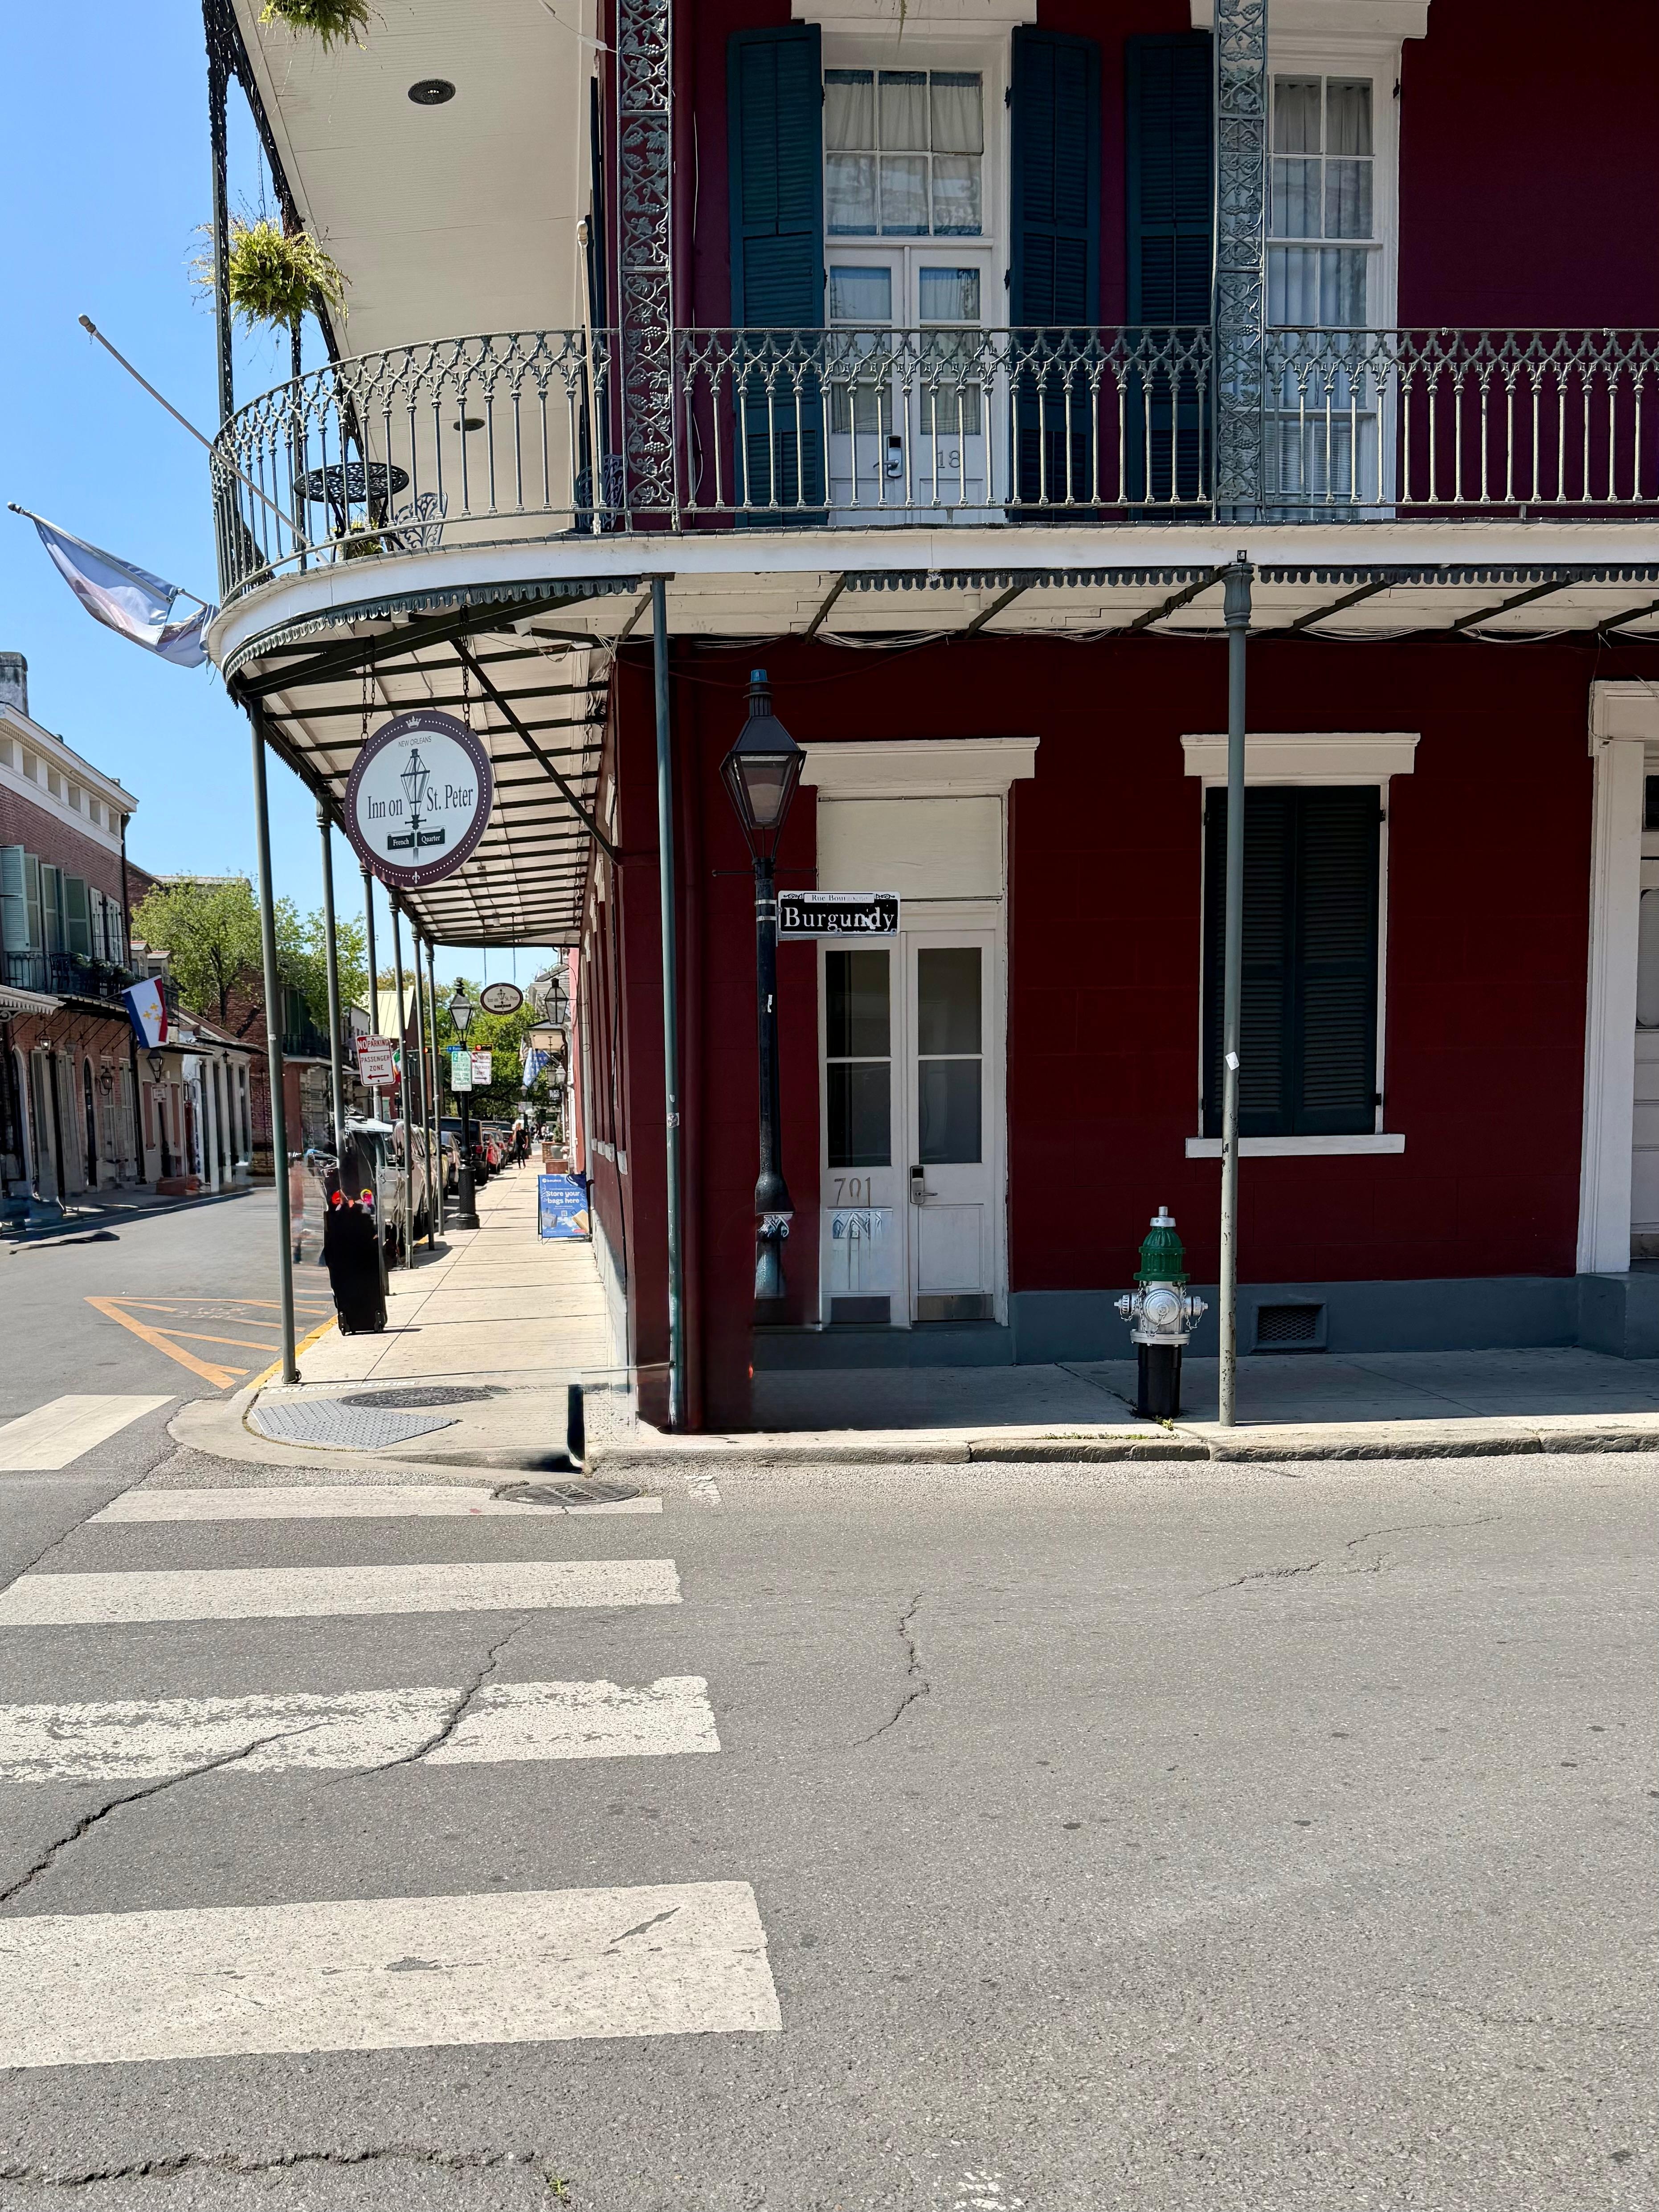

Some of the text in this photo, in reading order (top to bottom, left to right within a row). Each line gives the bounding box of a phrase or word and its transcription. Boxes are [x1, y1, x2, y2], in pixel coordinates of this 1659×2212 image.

[936, 450, 960, 468] 18
[410, 736, 432, 746] ORLEANS
[368, 785, 473, 819] Inn on St. Peter
[393, 835, 441, 846] French Quarter
[784, 907, 895, 931] Burgundy
[358, 1039, 389, 1050] NO PARKING
[834, 1177, 870, 1208] 701
